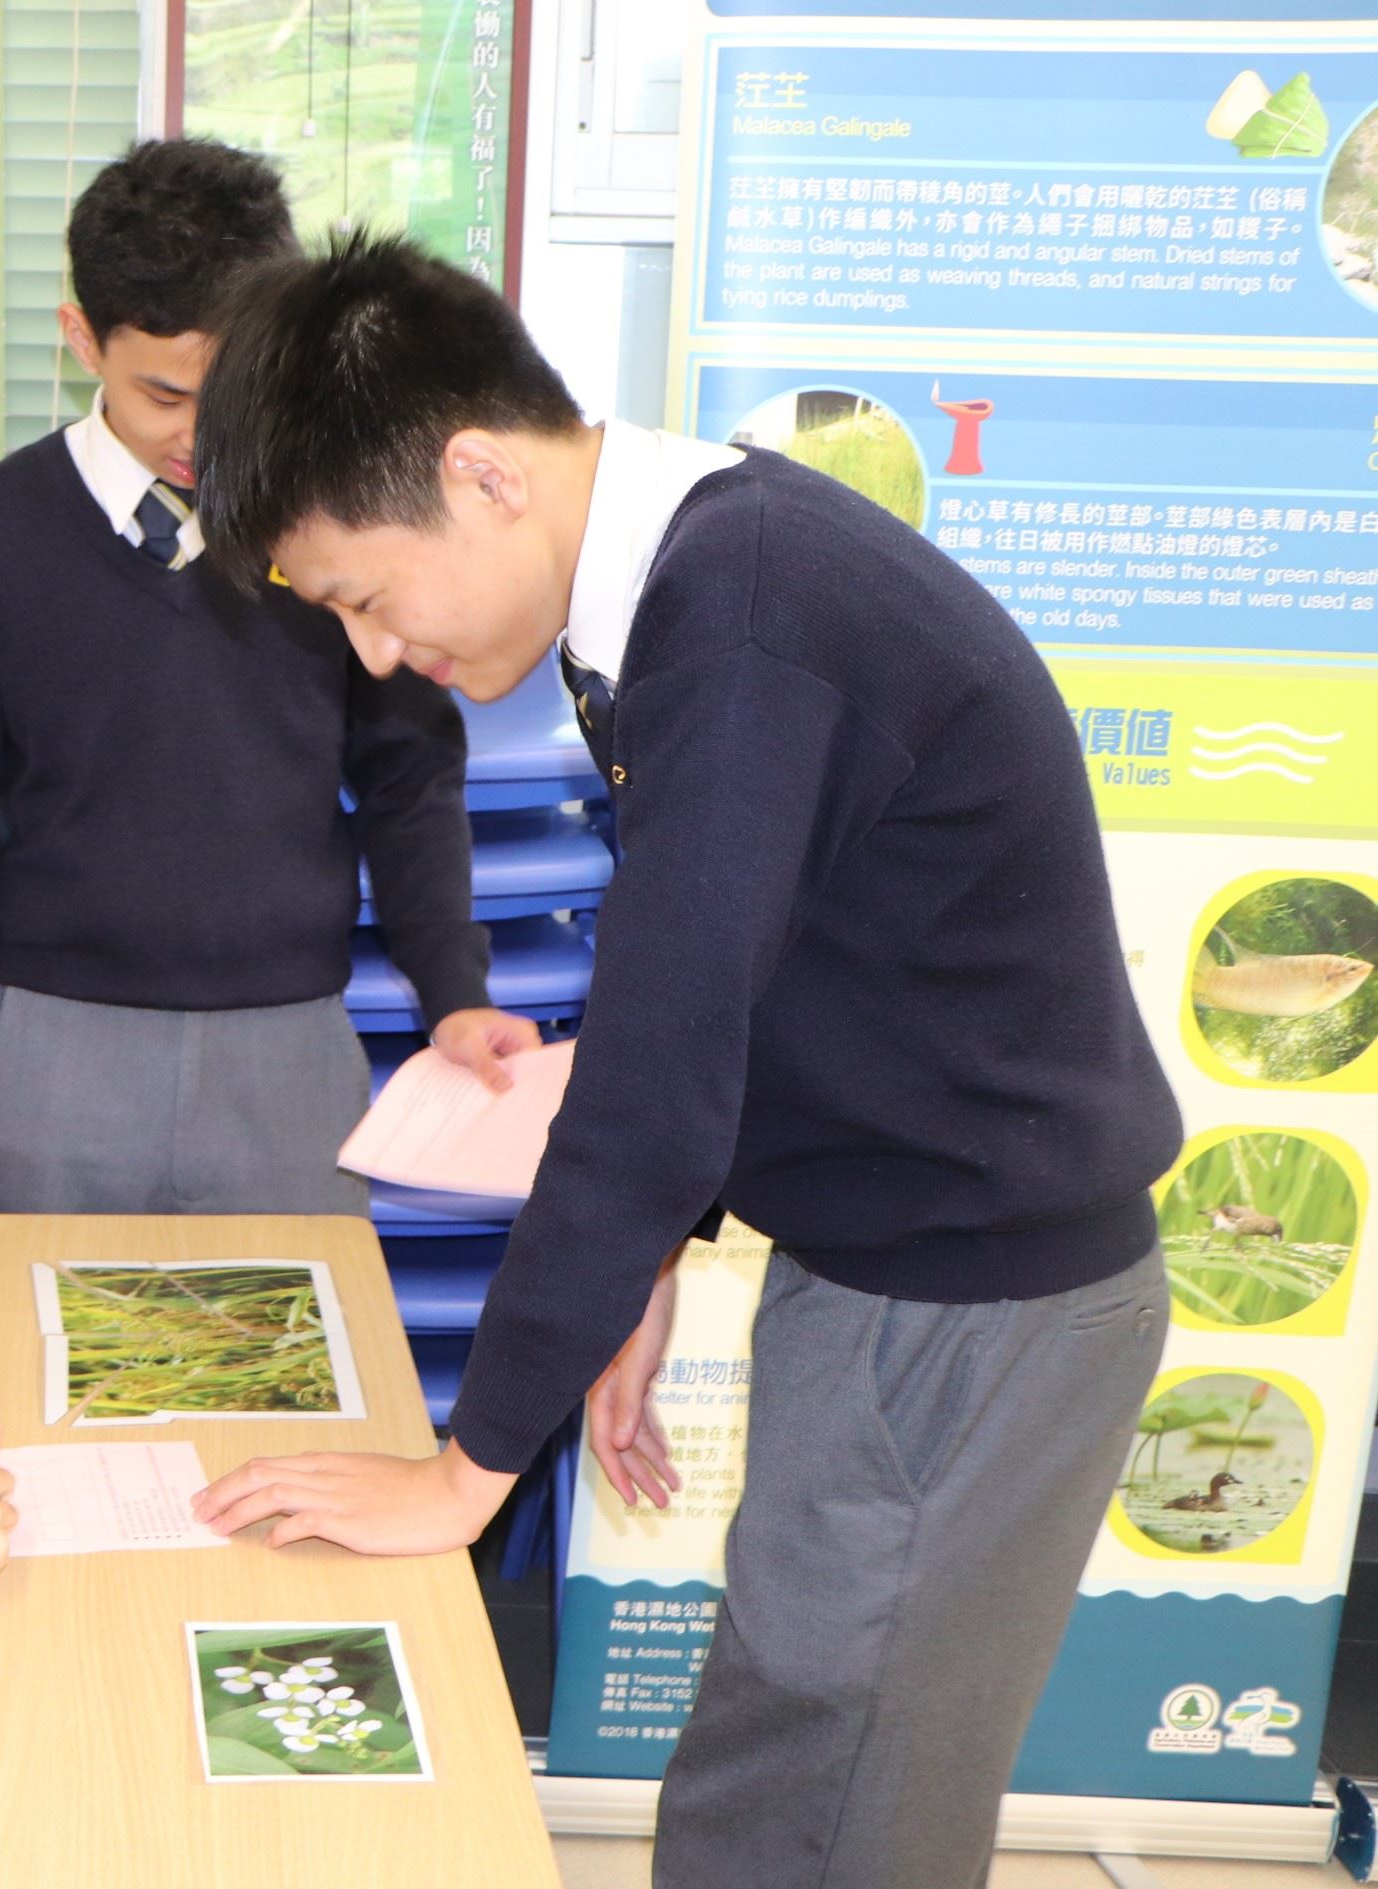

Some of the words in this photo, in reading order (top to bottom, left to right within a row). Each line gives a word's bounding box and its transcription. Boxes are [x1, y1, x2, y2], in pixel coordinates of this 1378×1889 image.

[735, 72, 809, 108] 茳芏
[733, 116, 815, 134] Malacea
[822, 116, 910, 140] Galingale
[725, 236, 803, 254] Malacea
[809, 237, 891, 258] Galingale
[898, 240, 927, 256] has
[935, 245, 945, 256] a
[951, 242, 989, 259] rigid
[996, 244, 1028, 257] and
[1035, 246, 1105, 264] angular
[1112, 247, 1158, 263] stem.
[1167, 246, 1214, 263] Dried
[1222, 250, 1274, 265] stems
[1279, 248, 1300, 265] of
[724, 262, 751, 279] the
[761, 263, 804, 283] plant
[812, 267, 840, 280] are
[850, 267, 893, 281] used
[899, 269, 919, 282] as
[928, 270, 1001, 288] weaving
[1010, 267, 1080, 289] threads,
[1089, 272, 1124, 288] and
[1132, 273, 1193, 290] natural
[1201, 274, 1261, 294] strings
[1269, 275, 1295, 292] for
[722, 288, 766, 308] tying
[775, 290, 807, 305] rice
[814, 291, 909, 311] dumplings.
[1017, 562, 1045, 575] are
[1052, 560, 1118, 576] slender.
[1126, 561, 1176, 579] Inside
[1182, 563, 1207, 578] the
[1214, 567, 1259, 581] outer
[1265, 570, 1317, 585] green
[1020, 584, 1064, 600] white
[1073, 588, 1136, 605] spongy
[1144, 588, 1201, 604] tissues
[1210, 590, 1241, 605] that
[1249, 593, 1292, 607] were
[1300, 594, 1345, 608] used
[1351, 598, 1373, 610] as
[1043, 610, 1069, 625] old
[1077, 611, 1121, 630] days.
[1069, 708, 1172, 755] 價值
[1104, 763, 1169, 784] Values
[698, 1392, 715, 1403] for
[692, 1470, 734, 1481] plants
[611, 1620, 646, 1633] Hong
[651, 1621, 685, 1633] Kong
[690, 1622, 714, 1631] Wet
[637, 1649, 681, 1657] Address
[631, 1689, 652, 1697] Fax
